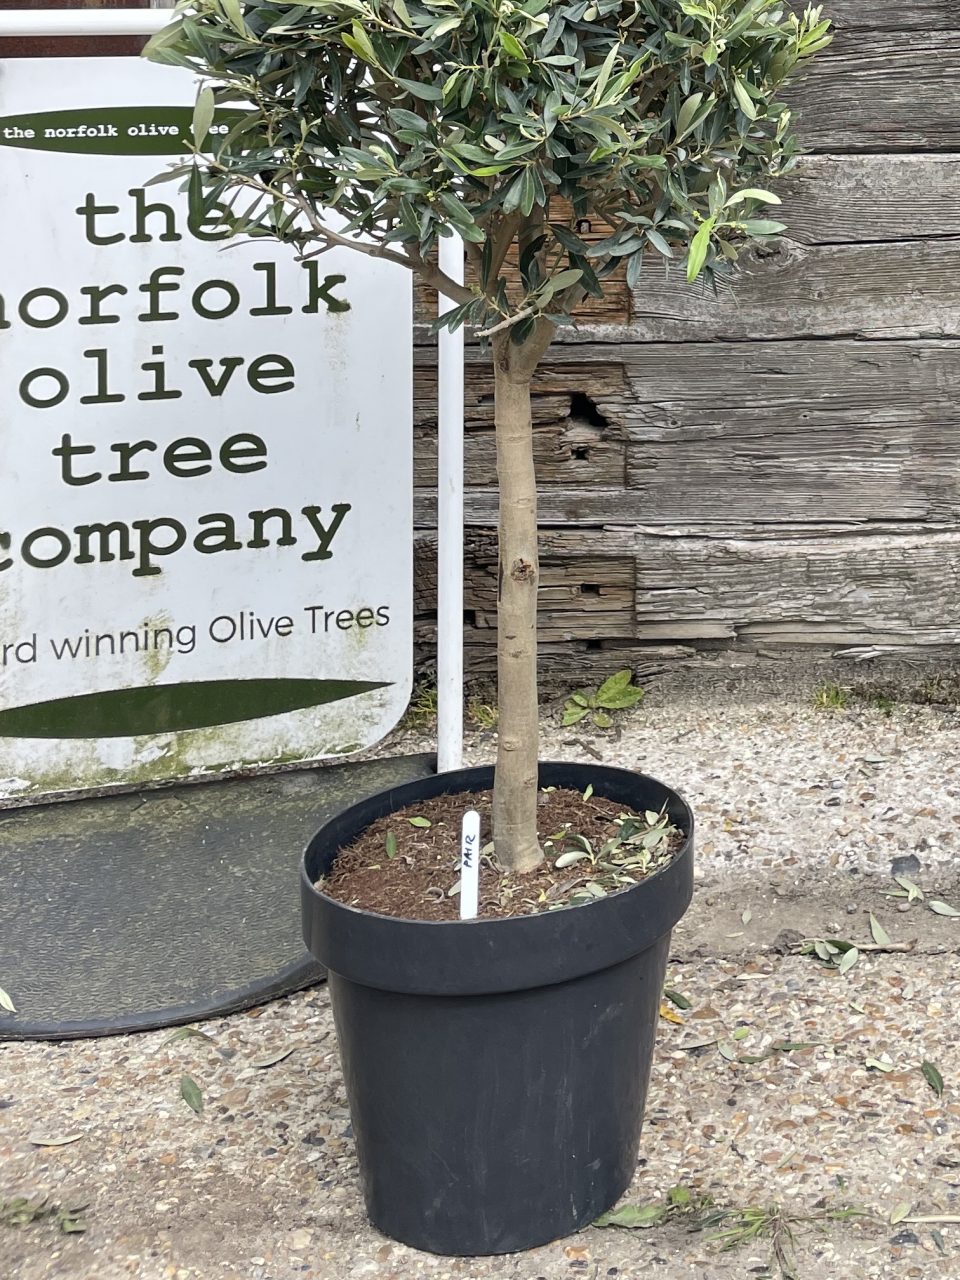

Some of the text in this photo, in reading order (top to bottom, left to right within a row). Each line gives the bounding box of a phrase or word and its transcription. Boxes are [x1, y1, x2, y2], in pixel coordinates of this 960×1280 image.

[3, 126, 36, 139] the
[44, 124, 119, 139] norfolk
[127, 123, 180, 137] olive
[76, 188, 236, 246] the
[0, 261, 352, 330] orfolk
[19, 345, 296, 409] olive
[52, 433, 268, 486] tree
[50, 621, 197, 660] winning
[209, 611, 294, 644] Olive
[304, 604, 391, 634] Trees
